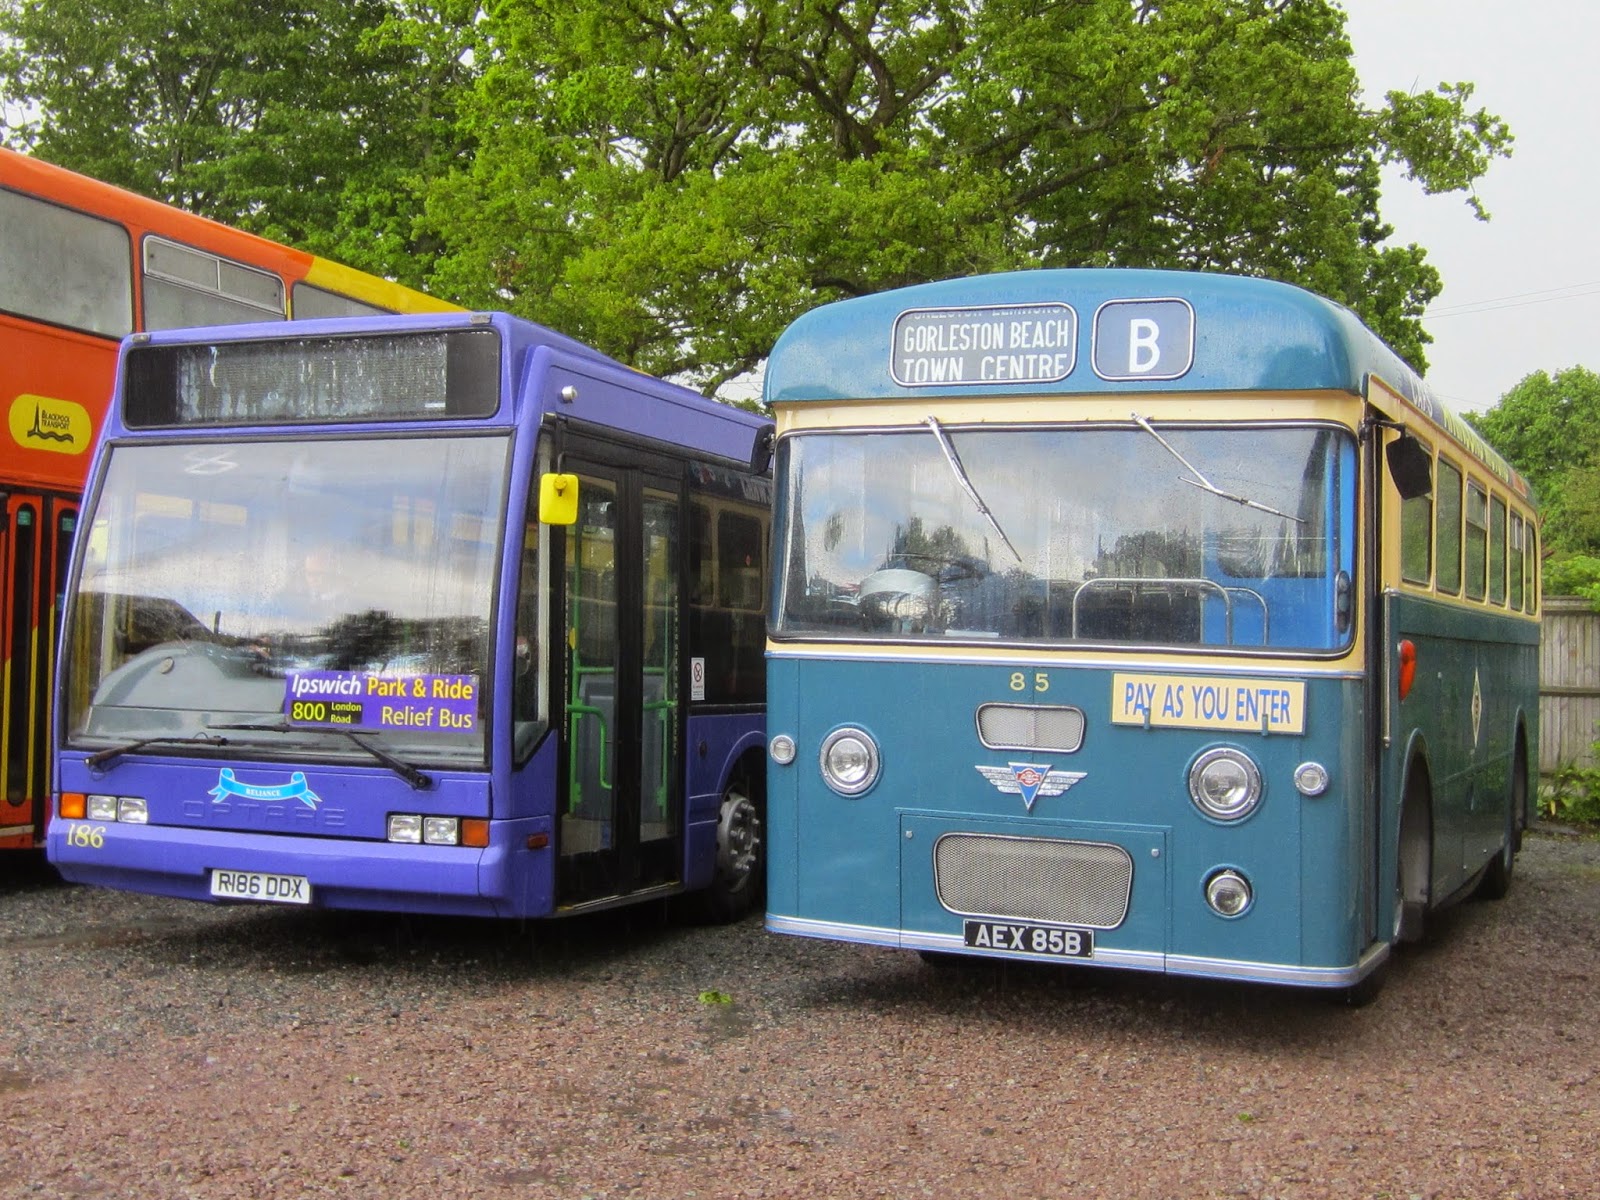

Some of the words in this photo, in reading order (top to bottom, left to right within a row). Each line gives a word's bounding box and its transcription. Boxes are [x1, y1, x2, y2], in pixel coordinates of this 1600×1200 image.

[904, 321, 1003, 353] GORLESTON
[1010, 319, 1069, 349] BEACH
[1129, 318, 1160, 373] B
[903, 356, 963, 382] TOWN
[980, 353, 1067, 380] CENTRE
[292, 674, 361, 697] Ipswich
[366, 677, 407, 697] Park
[413, 678, 426, 698] &
[432, 679, 473, 700] Ride
[292, 702, 325, 721] 800
[331, 702, 362, 712] London
[1124, 682, 1156, 716] PAY
[1162, 684, 1184, 718] AS
[1192, 686, 1229, 720] YOU
[1235, 688, 1291, 724] ENTER
[330, 714, 352, 724] Road
[381, 706, 433, 726] Relief
[439, 708, 473, 728] Bus
[245, 788, 282, 797] RELIANCE
[66, 823, 106, 849] 186
[266, 876, 302, 899] DDX
[974, 924, 1025, 950] AEX
[1031, 928, 1082, 955] 85B
